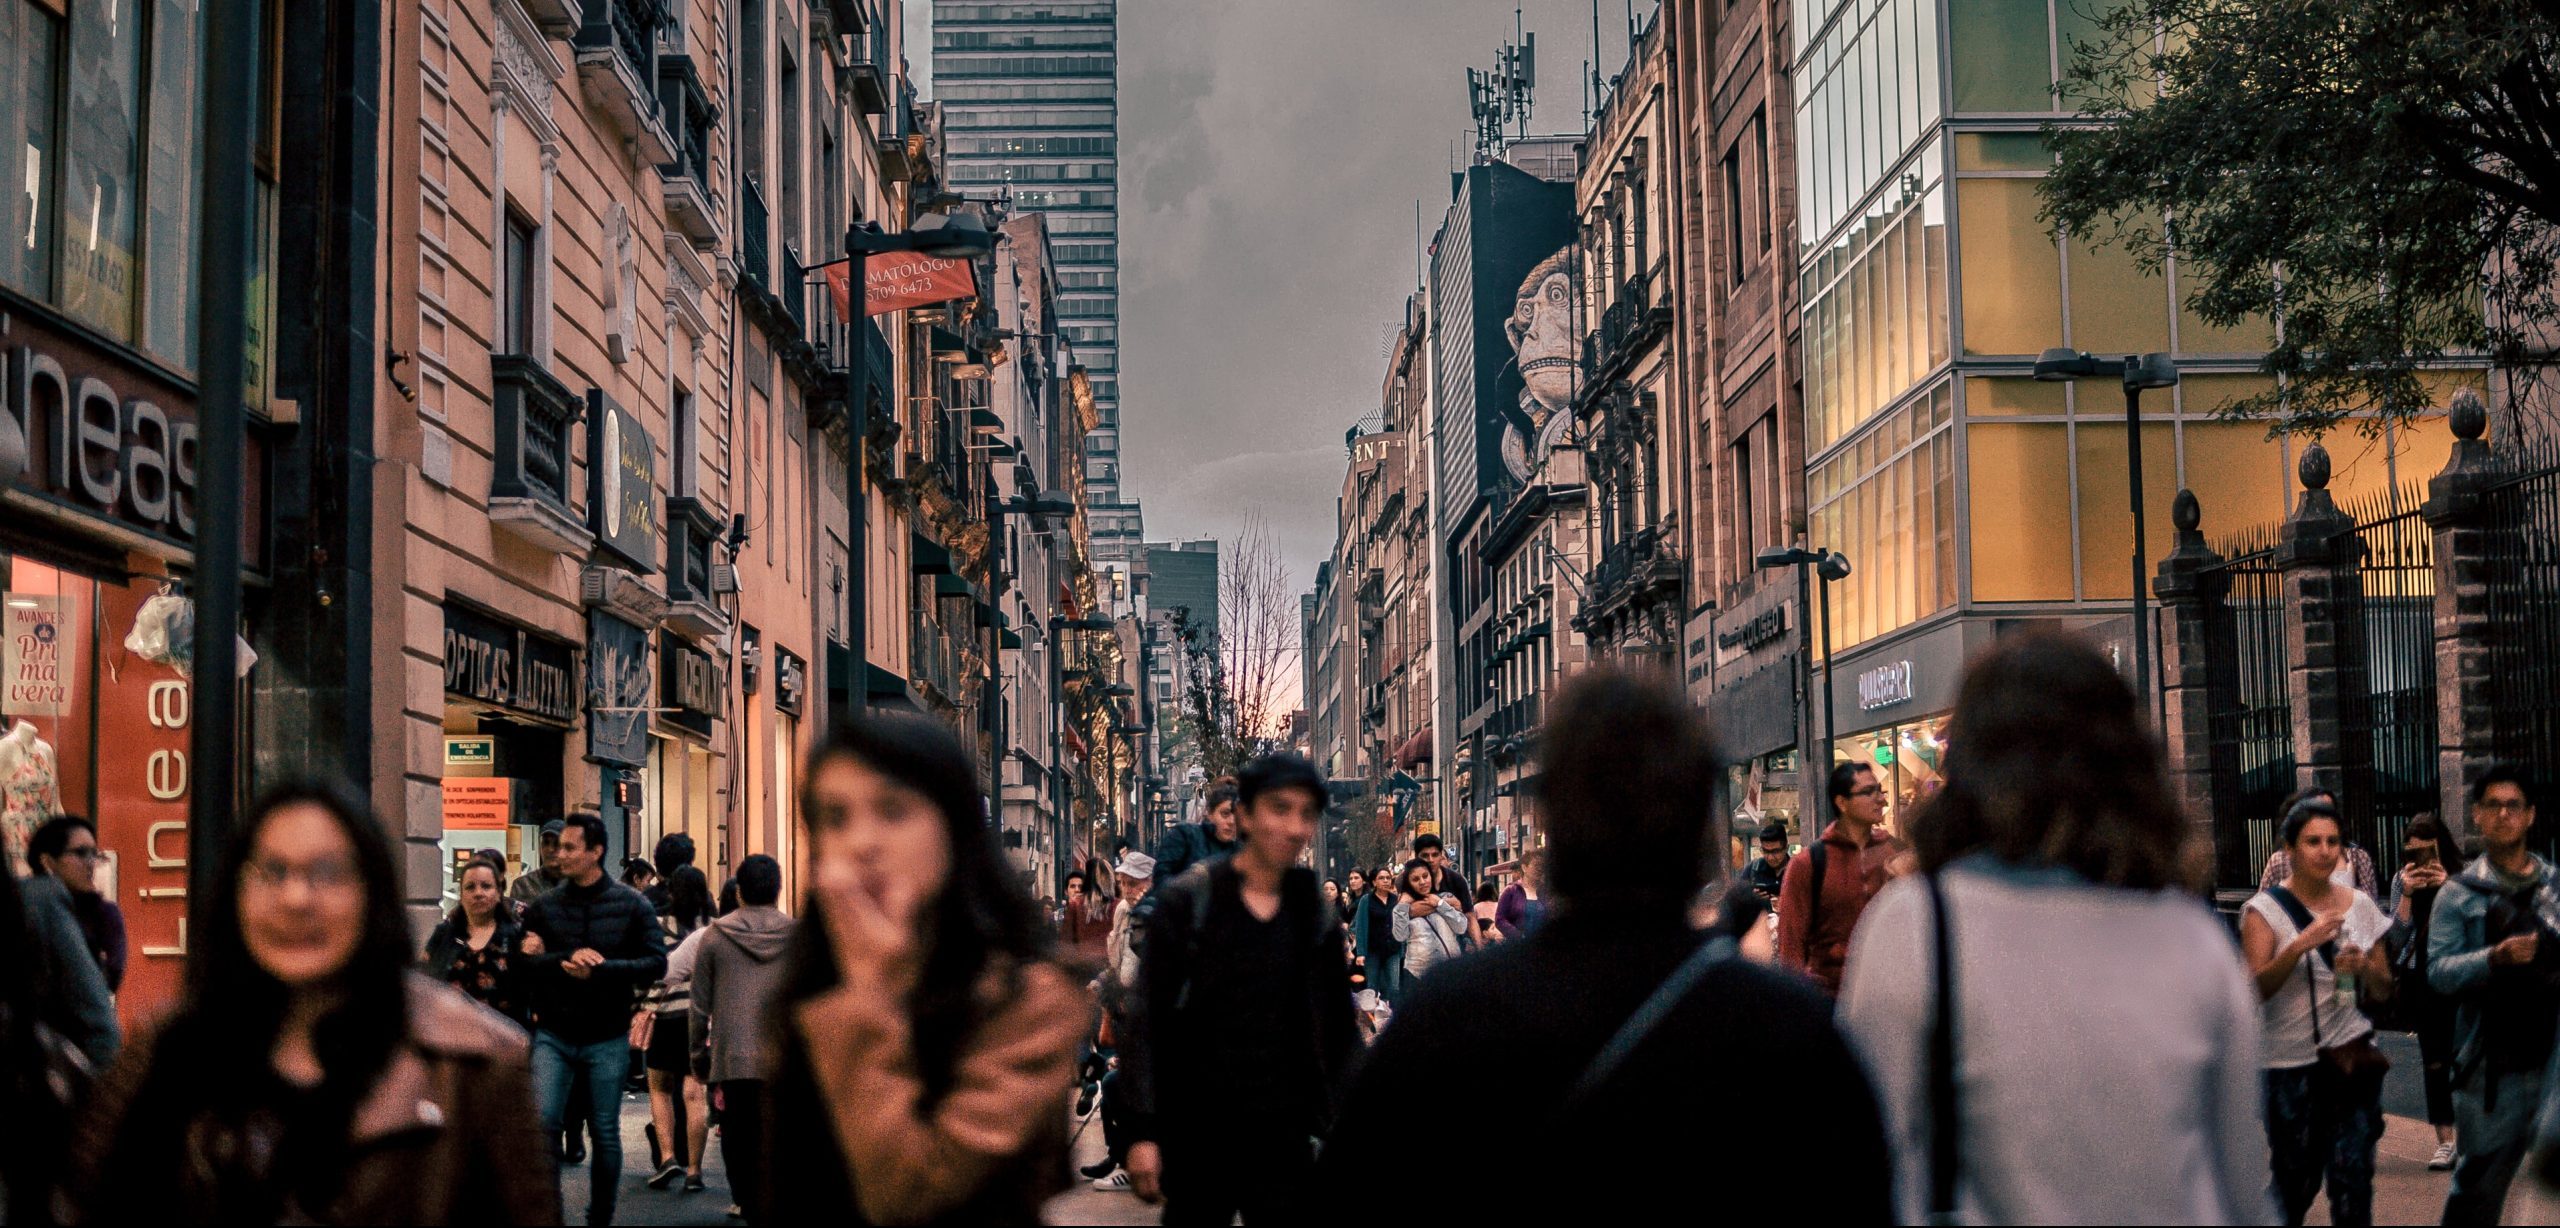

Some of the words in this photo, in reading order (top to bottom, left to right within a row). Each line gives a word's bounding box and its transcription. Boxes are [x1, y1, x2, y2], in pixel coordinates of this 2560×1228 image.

[840, 258, 955, 291] DMATÓLOGO
[865, 285, 896, 303] 5709
[900, 277, 933, 295] 6473
[17, 610, 65, 625] AVANCES
[17, 634, 56, 661] Pri
[20, 663, 57, 682] ma
[11, 684, 65, 704] vera
